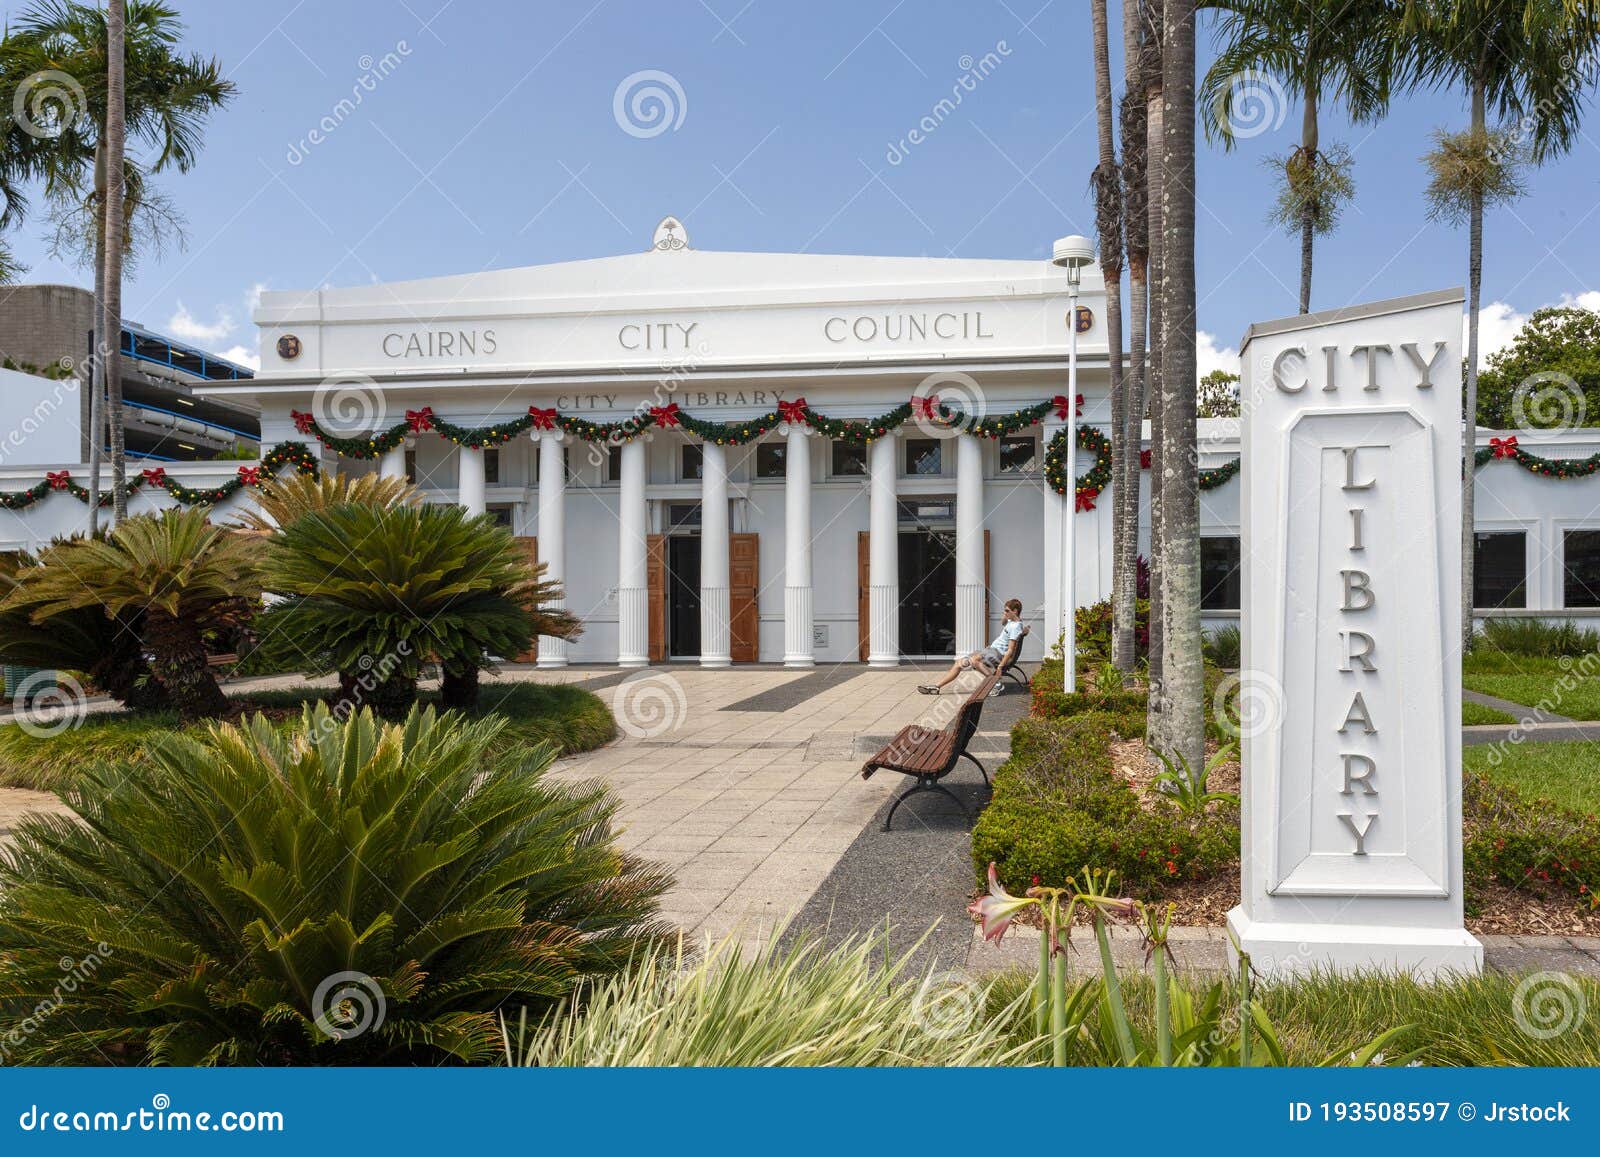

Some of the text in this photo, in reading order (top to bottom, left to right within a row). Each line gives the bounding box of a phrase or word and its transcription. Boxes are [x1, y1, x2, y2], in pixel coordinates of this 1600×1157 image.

[382, 311, 994, 358] CAIRNS CITY COUNCIL
[1272, 341, 1448, 394] CITY
[556, 393, 618, 410] CITY
[1336, 446, 1379, 856] LIBRARY
